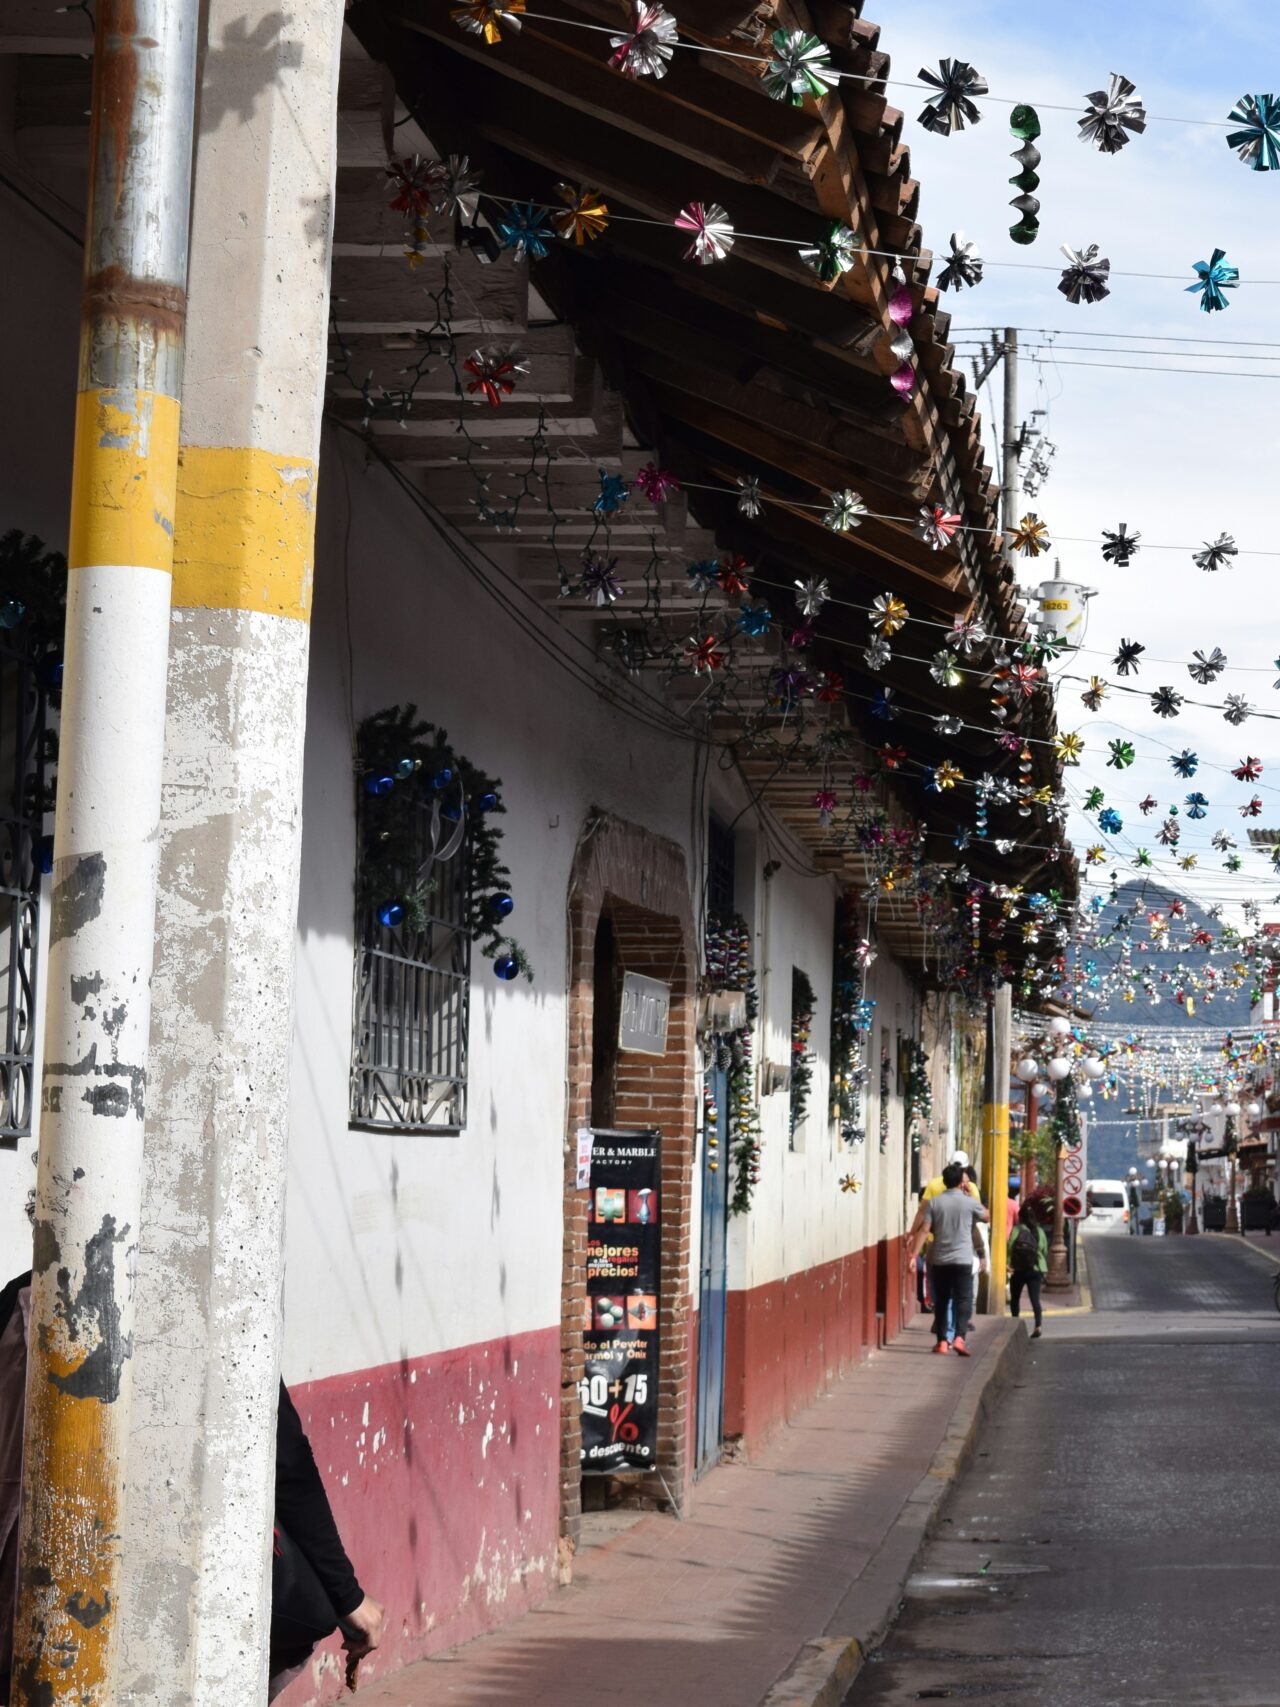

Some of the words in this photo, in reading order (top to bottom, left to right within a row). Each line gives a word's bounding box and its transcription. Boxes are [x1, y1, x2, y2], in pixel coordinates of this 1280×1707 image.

[607, 1147, 615, 1156] &
[617, 1148, 657, 1157] MARBLE
[587, 1265, 638, 1279] precios!
[600, 1340, 610, 1349] el
[613, 1339, 648, 1349] Pewter
[585, 1351, 613, 1360] armol
[617, 1352, 624, 1361] y
[590, 1442, 650, 1458] descuento
